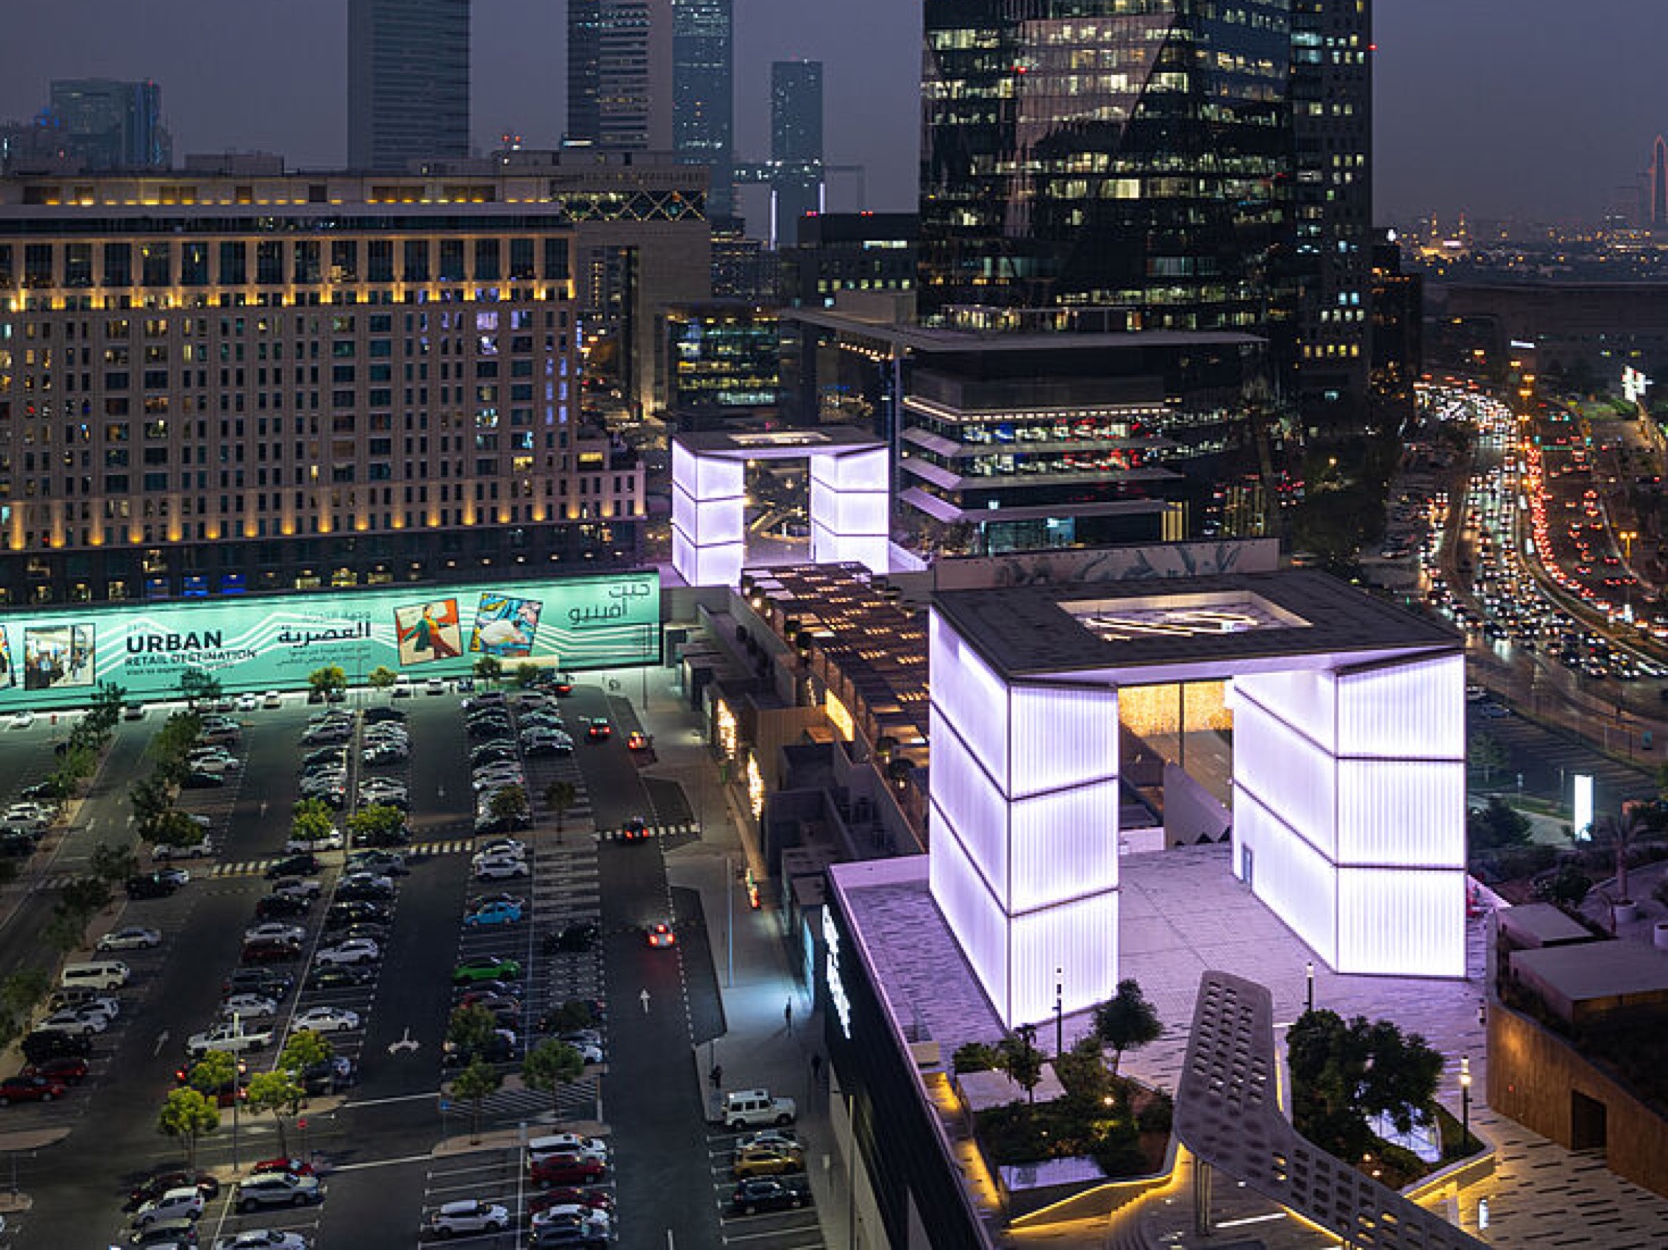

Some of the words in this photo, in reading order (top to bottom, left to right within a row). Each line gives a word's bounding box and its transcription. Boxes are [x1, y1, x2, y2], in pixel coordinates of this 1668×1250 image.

[126, 630, 222, 653] URBAN
[124, 653, 168, 667] RETAIL
[170, 648, 257, 664] DESTINATION
